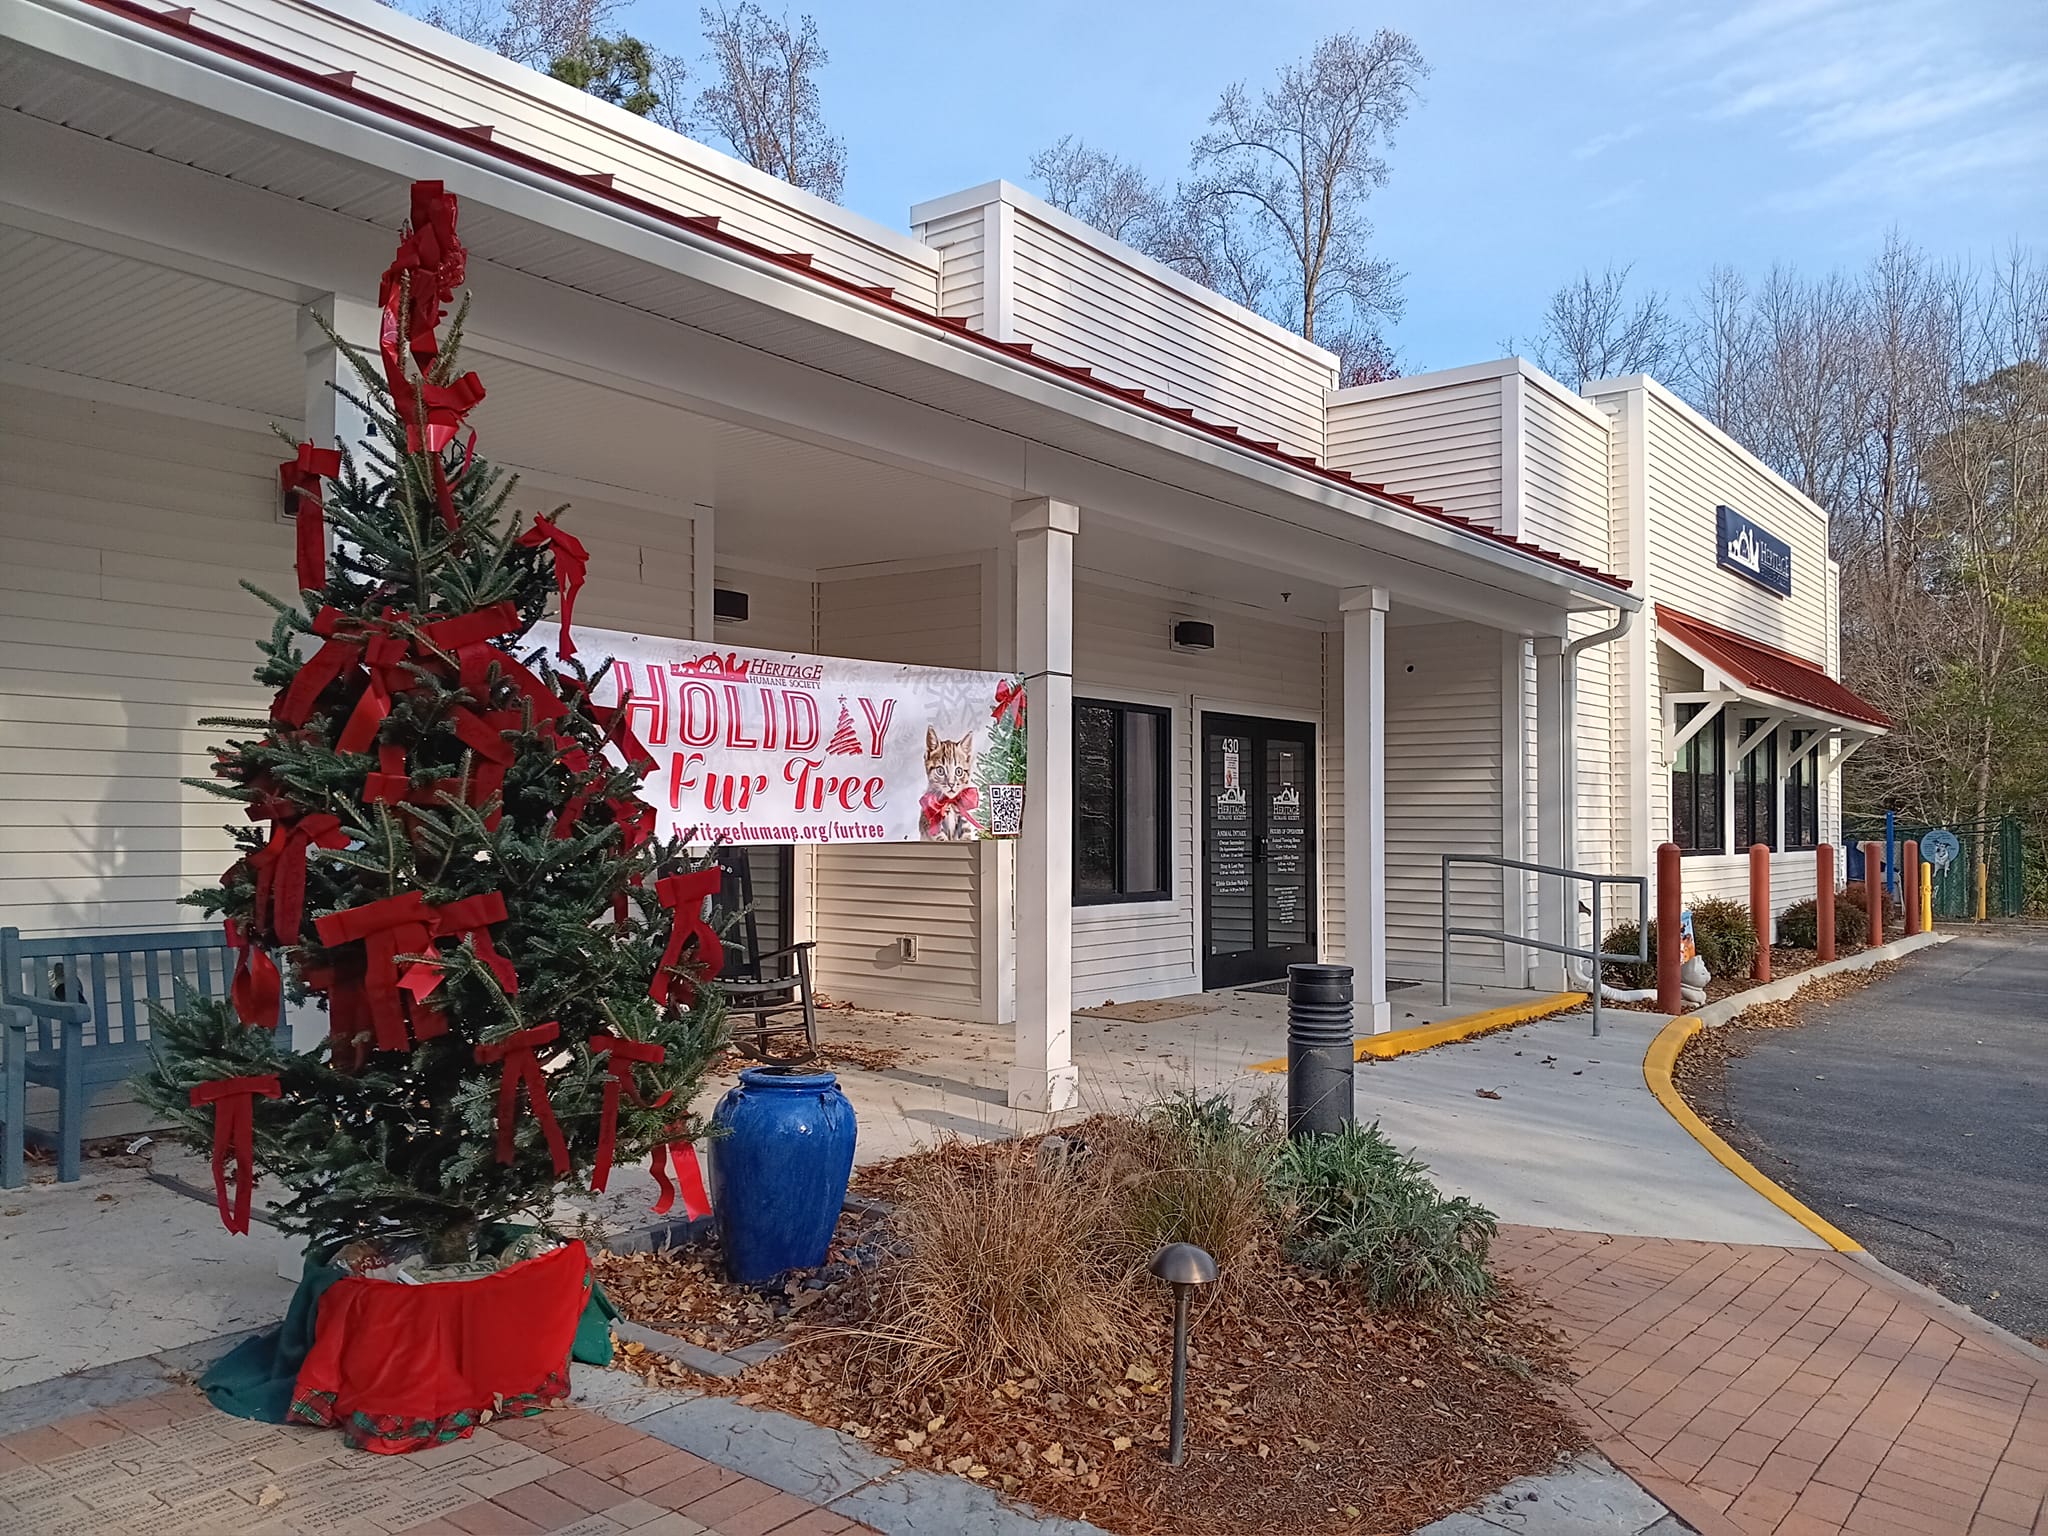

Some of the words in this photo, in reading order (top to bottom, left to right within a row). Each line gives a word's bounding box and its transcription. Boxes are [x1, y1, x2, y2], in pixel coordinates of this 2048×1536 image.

[750, 658, 824, 680] HERITAGE
[749, 675, 787, 687] HUMANE
[789, 679, 821, 690] SOCIETY
[1222, 738, 1239, 753] 430
[669, 751, 768, 812] Fur
[783, 756, 887, 812] Tree
